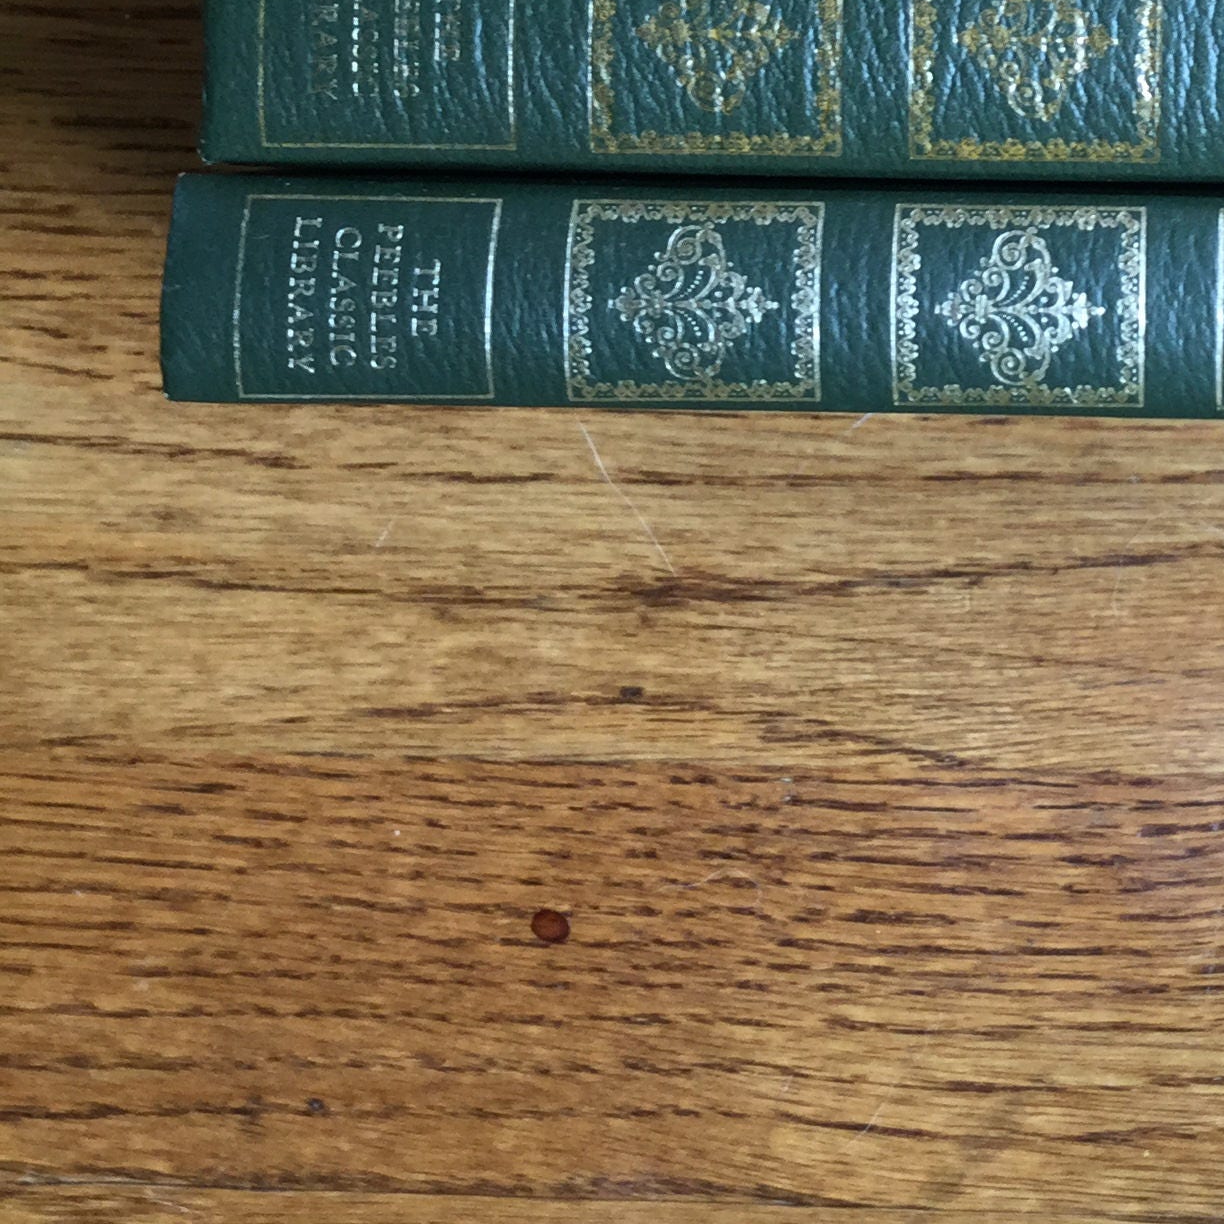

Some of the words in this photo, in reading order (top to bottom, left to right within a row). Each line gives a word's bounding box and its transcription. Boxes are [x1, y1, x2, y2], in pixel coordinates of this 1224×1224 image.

[287, 216, 322, 374] LIBRARY
[328, 227, 362, 366] CLASSIC
[370, 223, 404, 369] PEEBLES
[411, 258, 441, 336] THE
